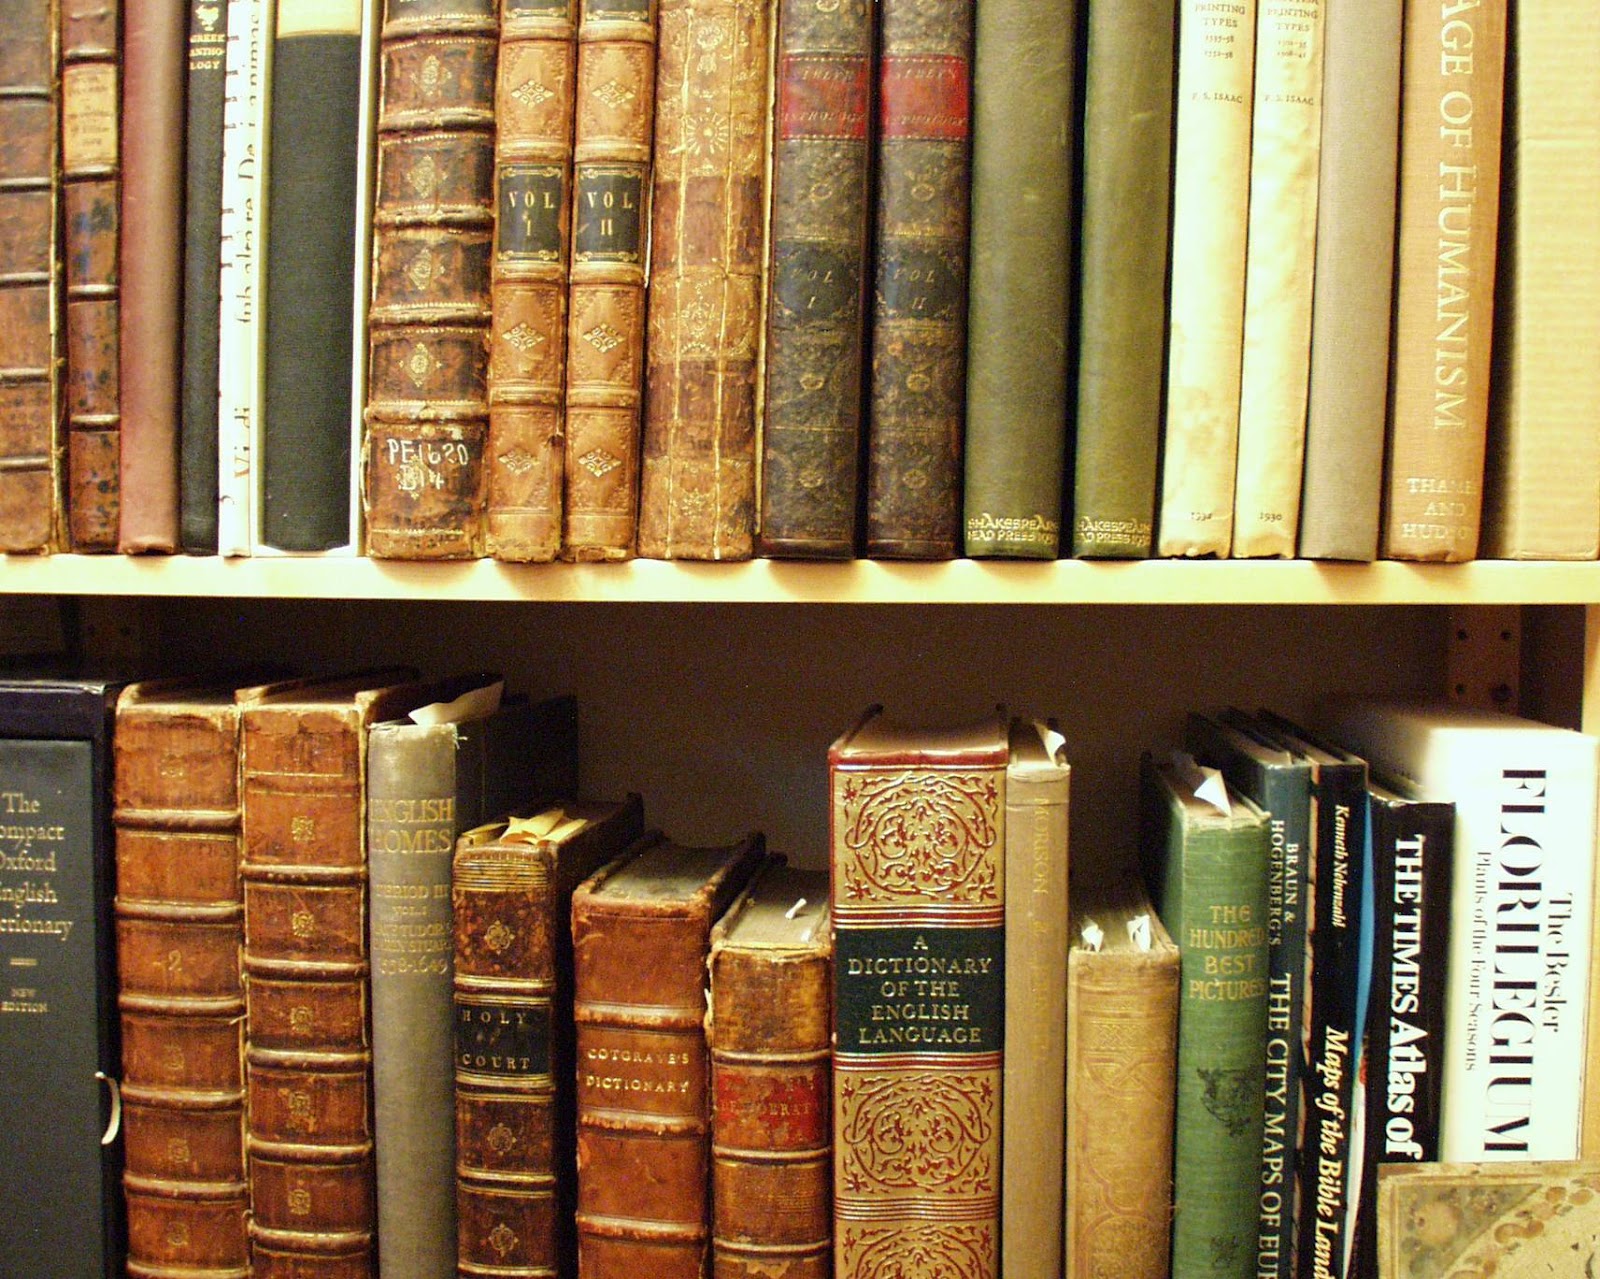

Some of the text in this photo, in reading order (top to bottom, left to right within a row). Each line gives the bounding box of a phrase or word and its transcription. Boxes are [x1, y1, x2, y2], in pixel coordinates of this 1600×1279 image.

[1195, 3, 1245, 15] PRINTING
[1268, 9, 1318, 19] PRINTING
[1203, 18, 1238, 28] TYPES
[1276, 23, 1310, 32] TYPES
[190, 34, 226, 43] GREEK
[190, 60, 220, 70] LOGY
[1214, 93, 1243, 104] ISAAC
[1286, 95, 1315, 106] ISAAC
[1439, 91, 1473, 148] OF
[508, 191, 555, 209] VOL
[587, 191, 633, 209] VOL
[601, 219, 613, 236] II
[791, 268, 834, 284] VOL
[893, 268, 935, 283] VOL
[1434, 162, 1477, 430] HUMANISM
[997, 531, 1035, 542] PRESS
[1096, 533, 1130, 544] PRESS
[2, 793, 40, 813] The
[370, 798, 455, 822] ENGLISH
[0, 825, 65, 847] ompact
[371, 829, 451, 853] HOMES
[1332, 804, 1350, 928] Kenneth Nebenzahl
[375, 884, 449, 898] PERIOD III
[1269, 820, 1285, 946] HOGENBERG'S
[1284, 843, 1299, 924] BRAUN &
[0, 881, 58, 909] nglish
[1209, 904, 1252, 924] THE
[913, 935, 928, 950] A
[1190, 927, 1265, 949] HUNDRED
[848, 957, 992, 975] DICTIONARY
[1204, 954, 1256, 974] BEST
[1465, 852, 1492, 1071] Plants of the Four Seasons
[1483, 769, 1547, 1155] FLORILEGIUM
[1542, 892, 1573, 1033] The Besler
[881, 981, 960, 997] OF THE
[1385, 834, 1428, 1160] THE TIMES Atlas of
[1, 1001, 48, 1012] EDITION
[1268, 972, 1292, 1031] THE
[462, 1009, 527, 1025] HOLY
[872, 1003, 970, 1021] ENGLISH
[859, 1027, 982, 1044] LANGUAGE
[462, 1054, 531, 1070] COURT
[587, 1048, 689, 1064] COTGRAVE'S
[1316, 1025, 1349, 1090] Maps
[1265, 1038, 1290, 1106] CITY
[586, 1075, 689, 1093] DICTIONARY
[1314, 1092, 1345, 1120] of
[1319, 1119, 1344, 1156] the
[1261, 1111, 1286, 1185] MAPS
[1316, 1155, 1342, 1218] Bible
[1259, 1191, 1282, 1227] OF
